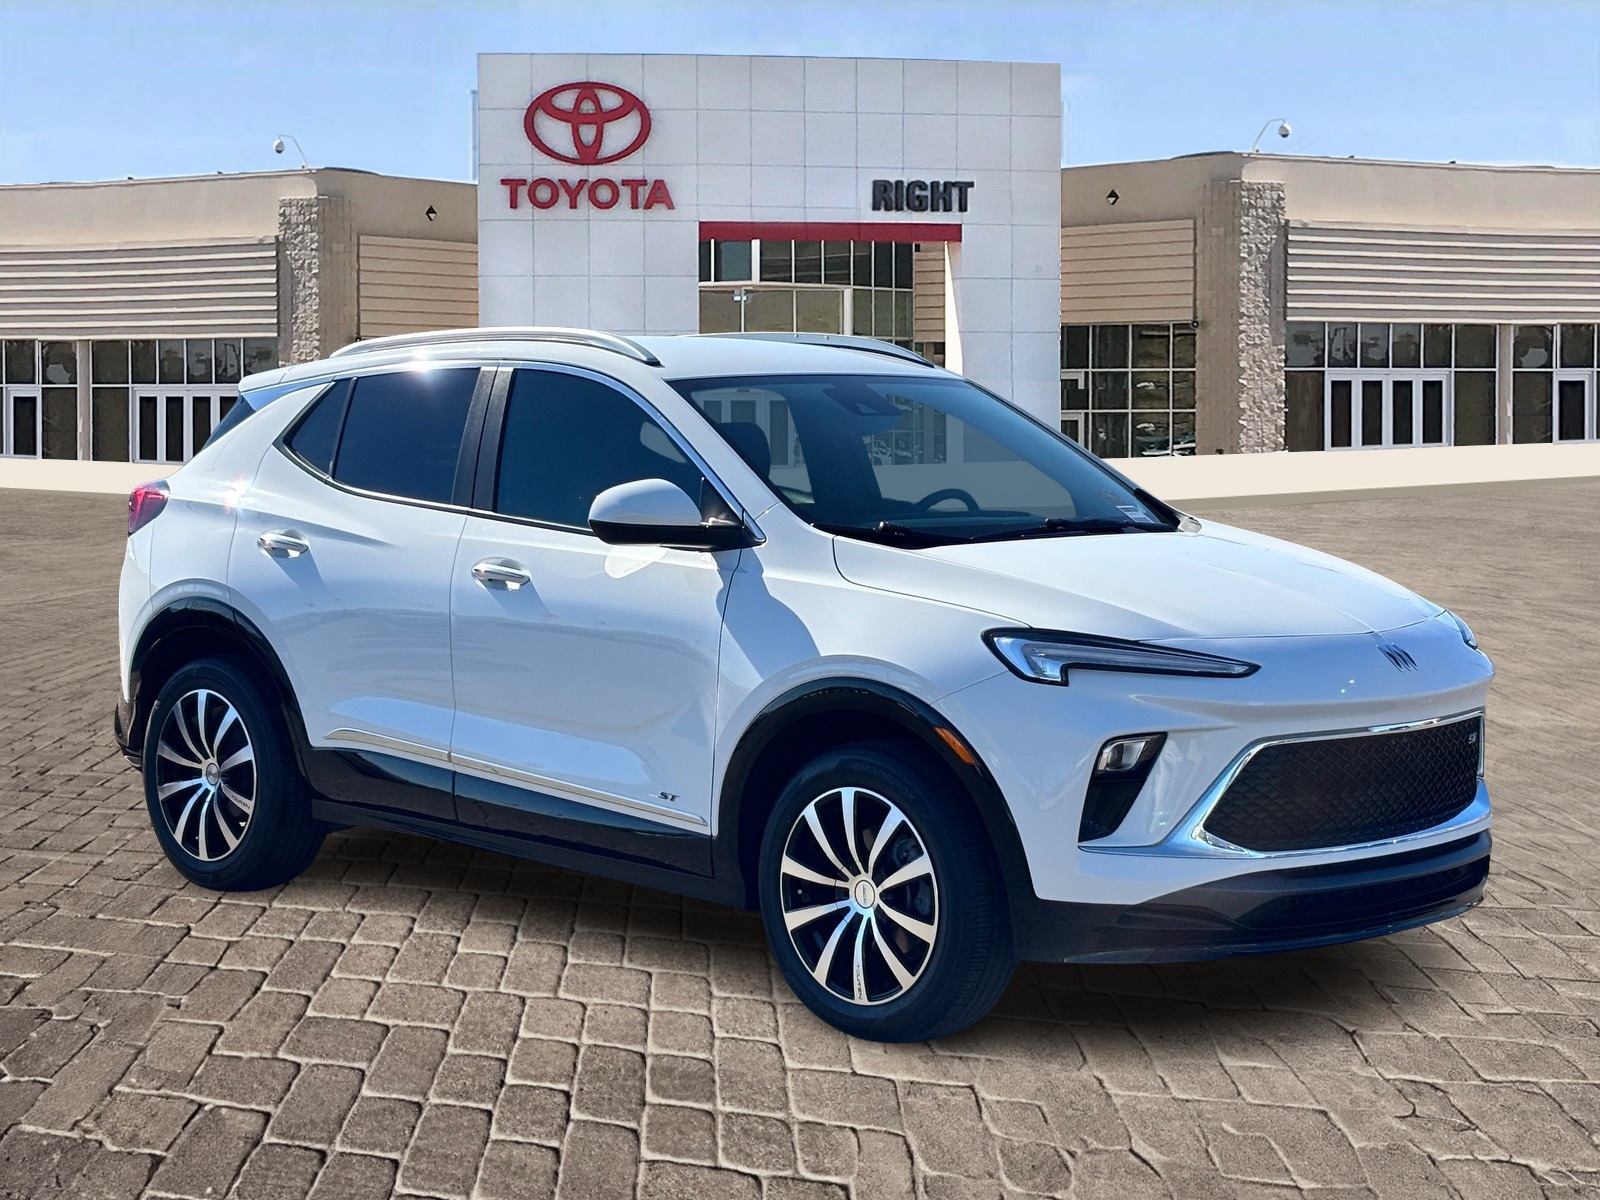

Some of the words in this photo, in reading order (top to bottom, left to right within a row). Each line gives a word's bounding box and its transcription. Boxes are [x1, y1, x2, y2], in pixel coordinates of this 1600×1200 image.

[500, 178, 675, 209] TOYOTA
[872, 179, 975, 212] RIGHT
[658, 791, 680, 801] ST
